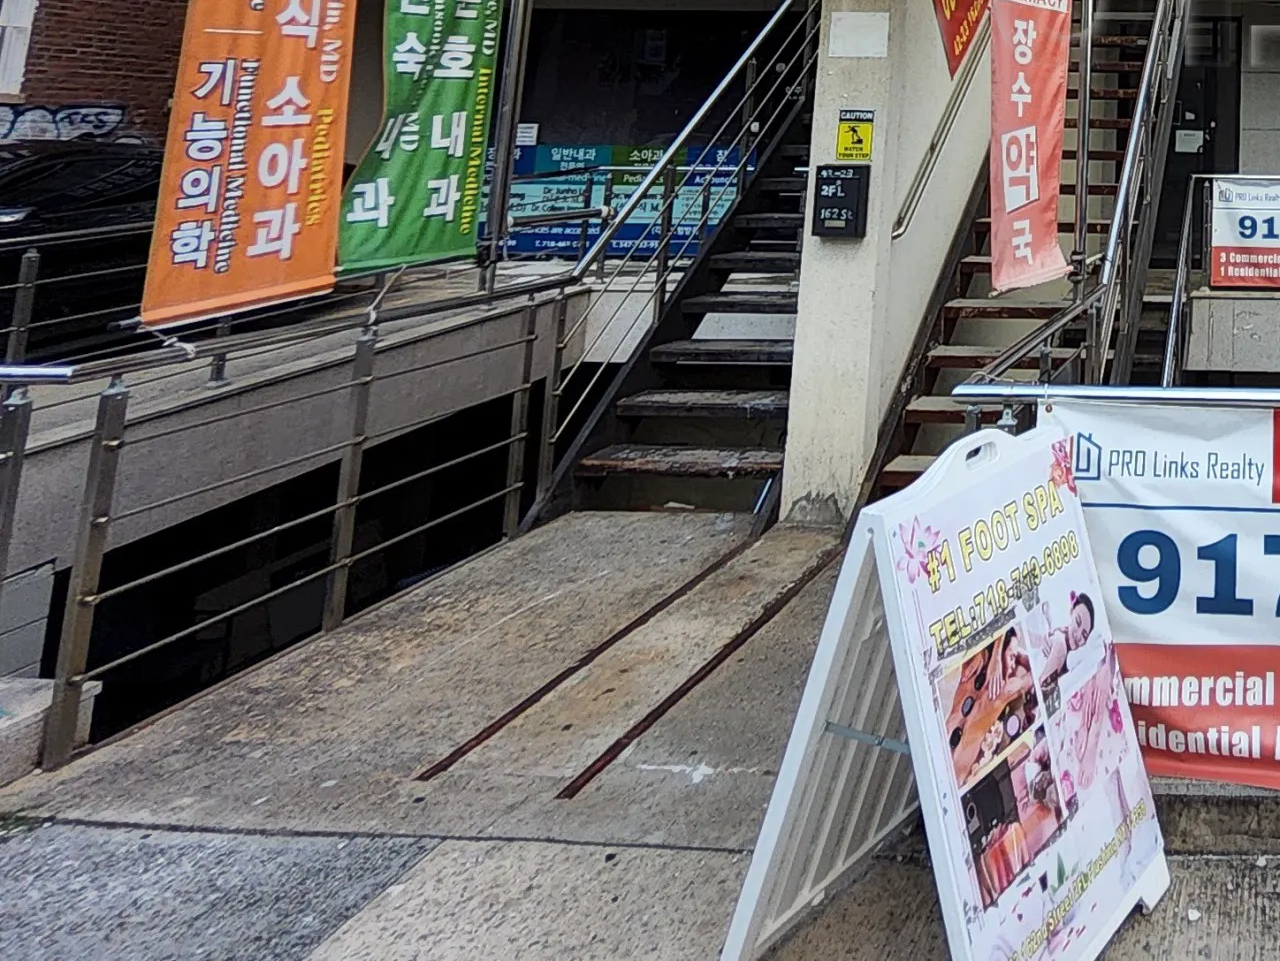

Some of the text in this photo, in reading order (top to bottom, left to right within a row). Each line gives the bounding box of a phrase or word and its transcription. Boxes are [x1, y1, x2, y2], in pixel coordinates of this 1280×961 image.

[480, 19, 499, 56] MD
[319, 38, 343, 83] MD
[840, 111, 873, 120] CAUTION
[171, 57, 237, 269] 기능의학
[246, 73, 313, 260] 소아과
[422, 111, 468, 223] 내과
[551, 147, 597, 161] 일반내과
[628, 149, 664, 162] 소아과
[820, 208, 839, 219] 162
[1235, 192, 1247, 201] PRO
[1220, 253, 1227, 263] 3
[1220, 267, 1226, 277] 1
[1107, 449, 1265, 487] PRO Links Realty
[925, 479, 1065, 594] #1 FOOT SPA
[1124, 671, 1275, 708] mmercial
[1137, 720, 1262, 759] idential
